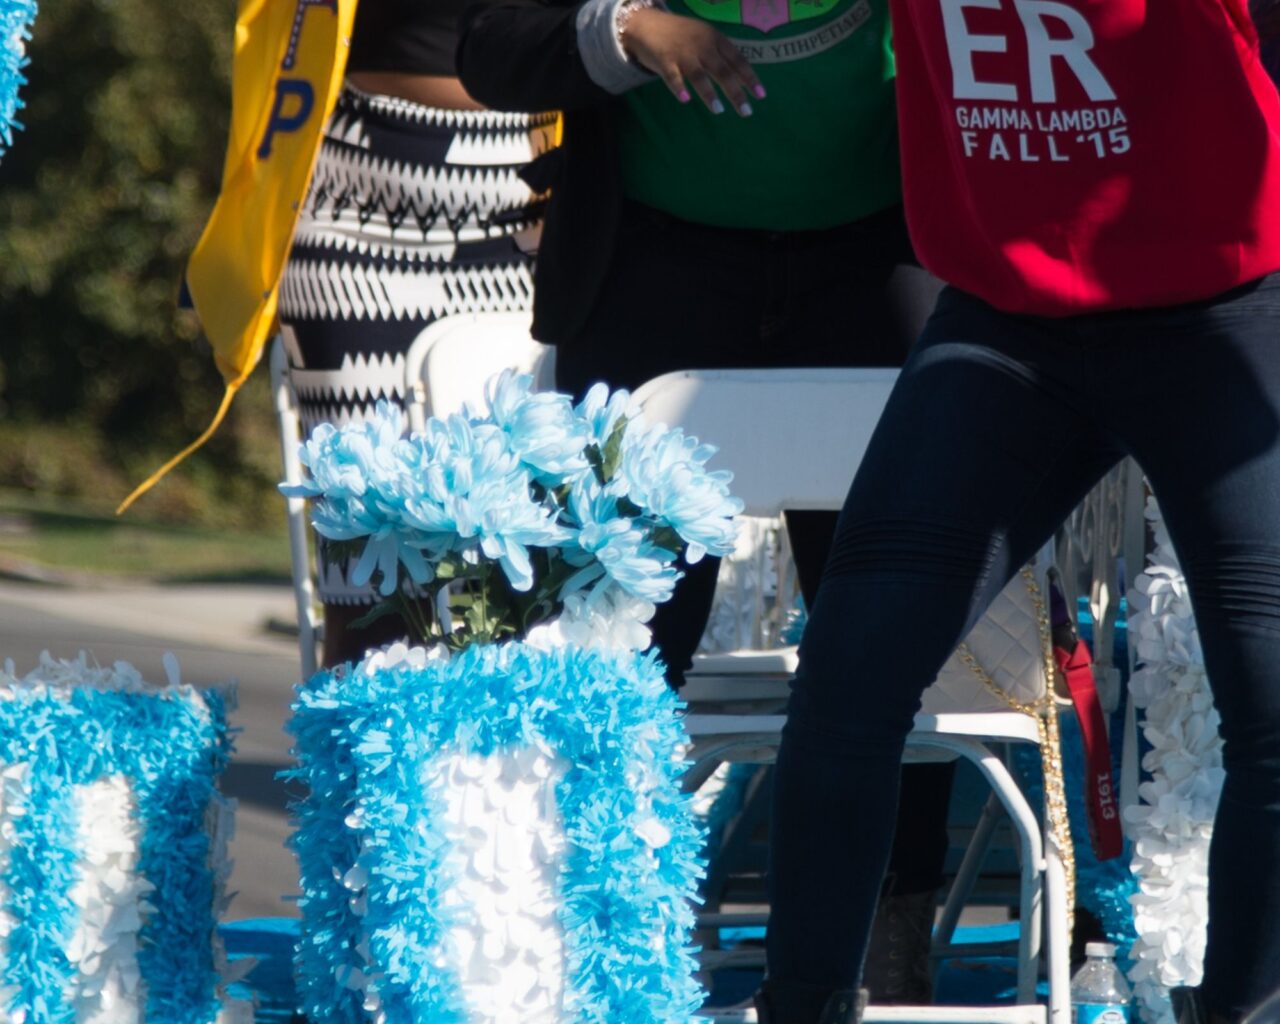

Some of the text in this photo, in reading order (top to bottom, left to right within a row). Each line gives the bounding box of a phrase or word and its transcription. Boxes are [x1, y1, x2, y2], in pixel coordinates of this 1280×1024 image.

[956, 106, 1127, 132] GAMMA LAMBDA
[961, 131, 1070, 162] FALL
[1097, 772, 1115, 821] 1913
